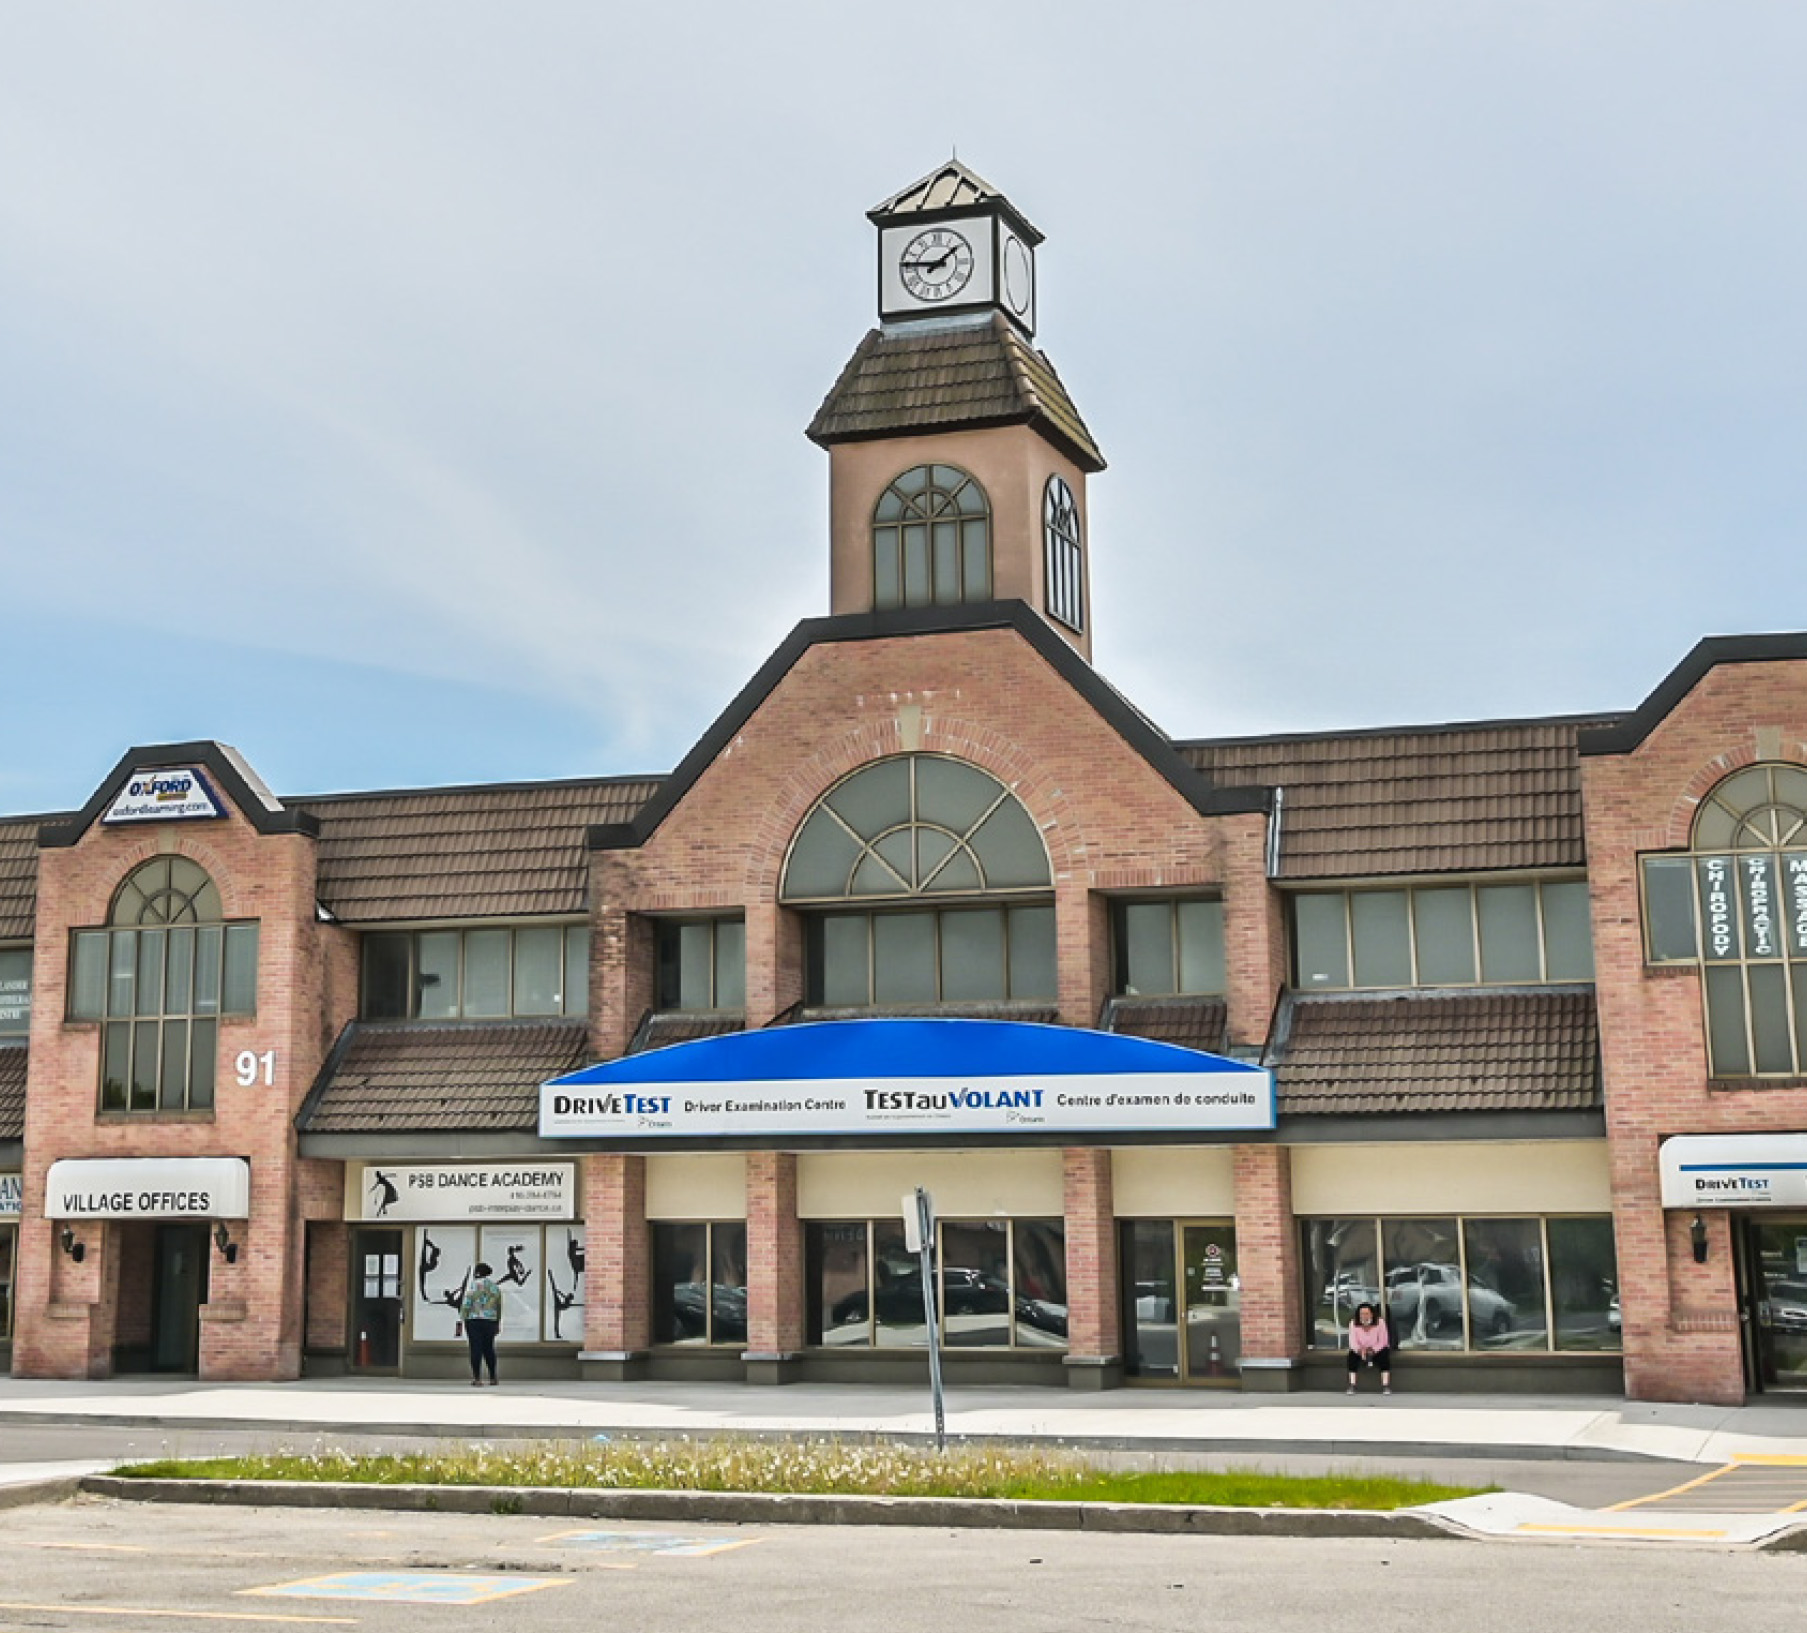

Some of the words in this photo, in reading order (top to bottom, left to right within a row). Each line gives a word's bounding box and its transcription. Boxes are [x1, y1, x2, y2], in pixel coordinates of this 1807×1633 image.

[1707, 859, 1731, 957] CHIROPODY
[1747, 858, 1772, 956] CHIROPRACTIC
[235, 1050, 275, 1086] 91
[684, 1100, 721, 1112] Driver
[725, 1100, 802, 1112] Examination
[804, 1099, 847, 1111] Centre
[1056, 1093, 1101, 1106] Centre
[1105, 1093, 1170, 1106] d'examen
[1173, 1092, 1191, 1106] de
[1194, 1091, 1256, 1106] conduite
[408, 1172, 434, 1189] PSB
[438, 1172, 487, 1188] DANCE
[491, 1171, 564, 1187] ACADEMY
[62, 1191, 134, 1212] VILLAGE
[137, 1191, 211, 1211] OFFICES
